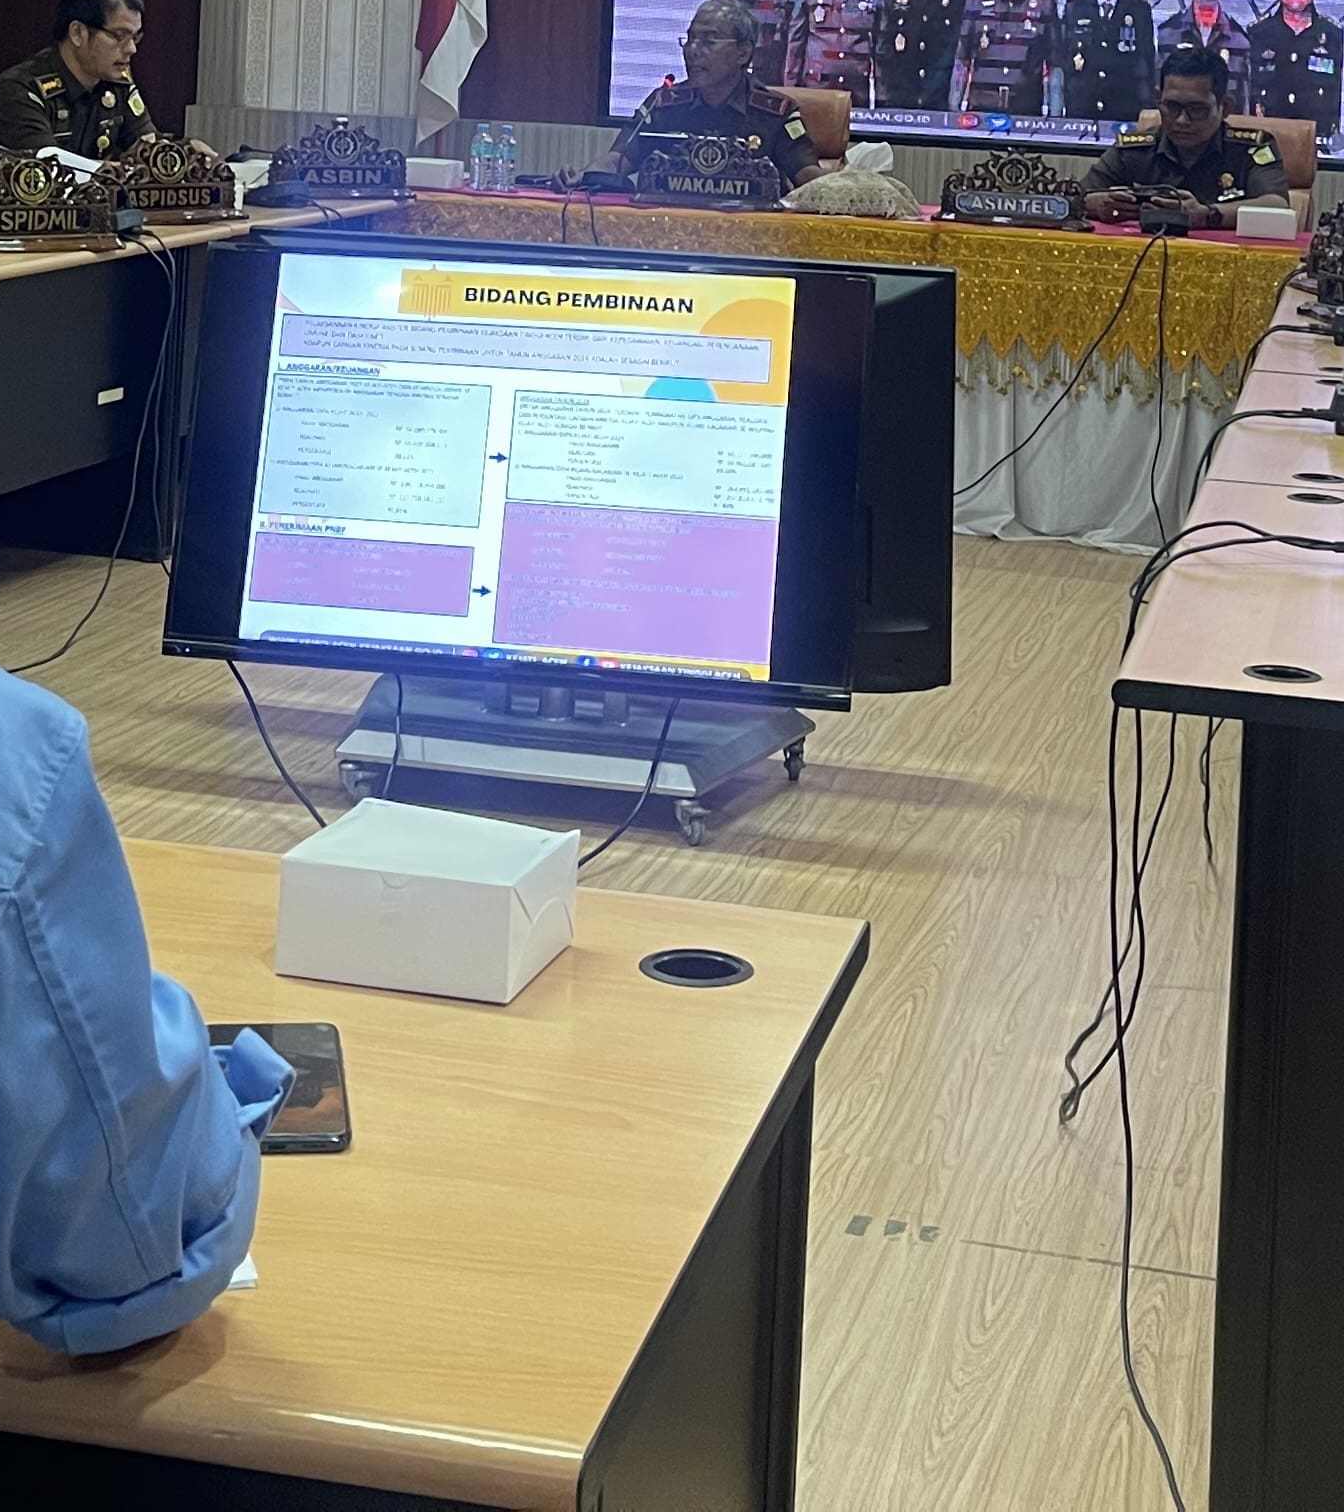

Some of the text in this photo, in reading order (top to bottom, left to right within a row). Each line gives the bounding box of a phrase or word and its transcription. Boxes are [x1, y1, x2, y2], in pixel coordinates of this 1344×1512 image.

[849, 110, 931, 124] KSAAN.GO.ID
[303, 169, 382, 185] ASBIN
[668, 176, 749, 195] WAKAJATI
[128, 188, 210, 208] ASPIDSUS
[971, 196, 1054, 215] ASINTEL
[464, 287, 694, 314] BIDANG PEMBINAAN
